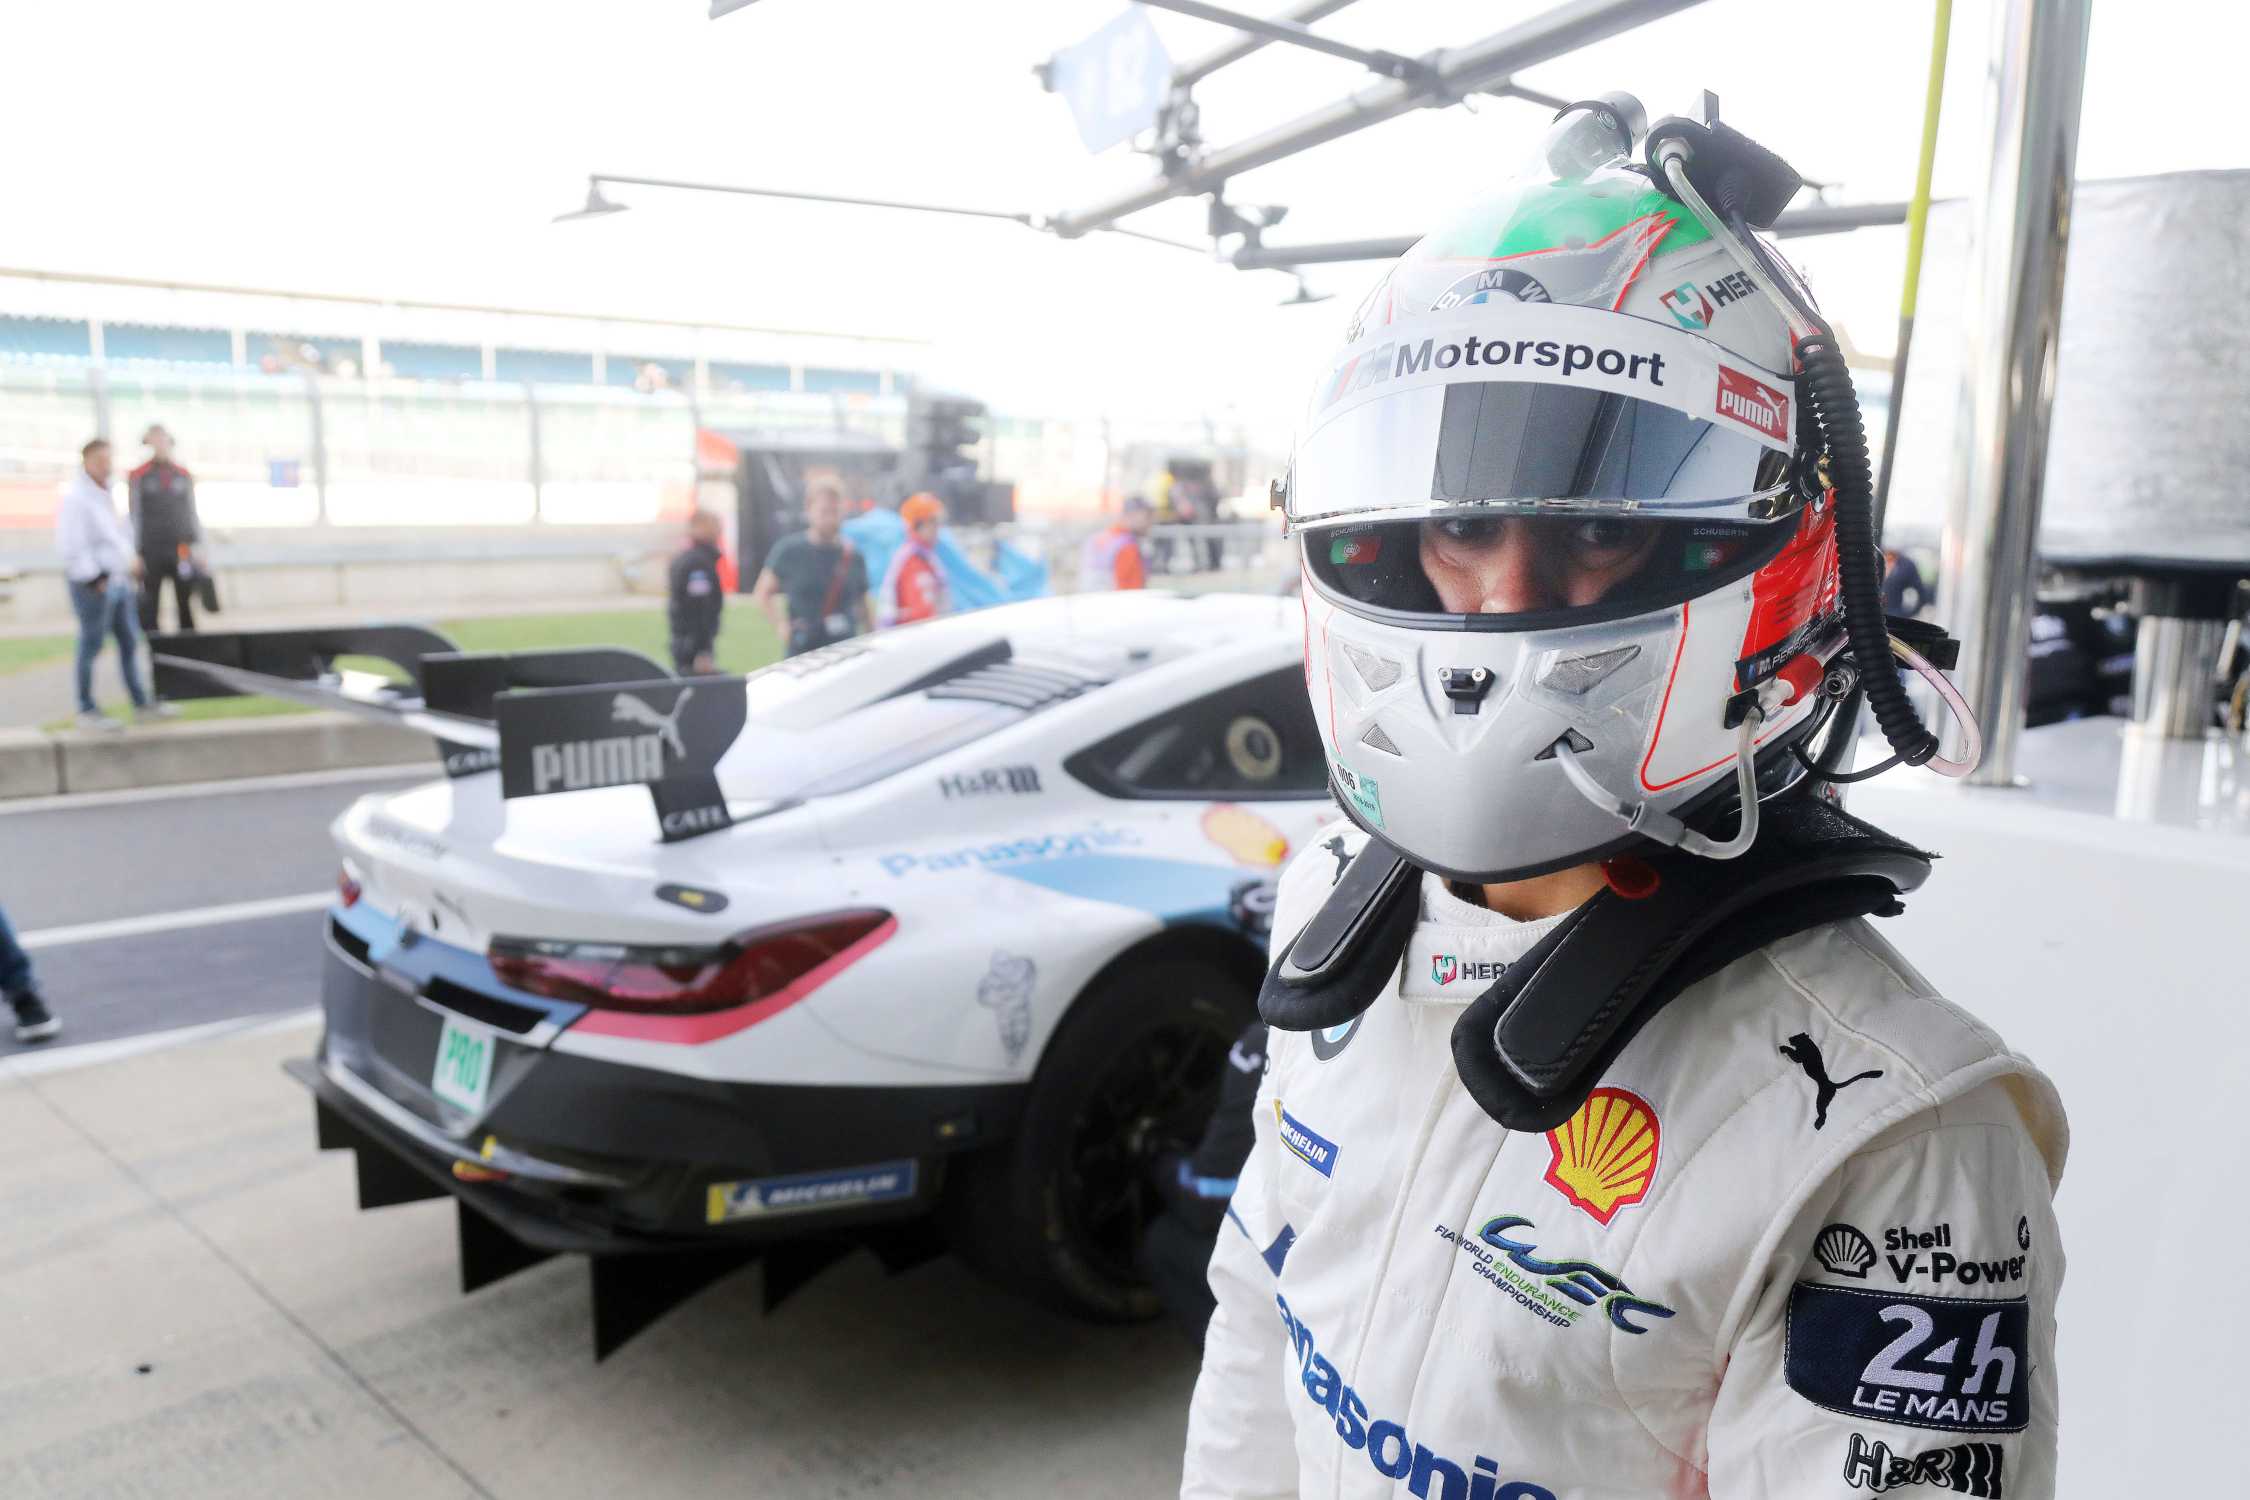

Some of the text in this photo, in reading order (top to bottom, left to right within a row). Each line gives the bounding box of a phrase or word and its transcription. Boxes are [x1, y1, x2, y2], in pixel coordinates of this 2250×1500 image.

[1705, 270, 1759, 308] HER
[1395, 336, 1665, 386] Motorsport
[1720, 389, 1774, 431] PUMA
[1693, 527, 1749, 537] SCHUBERTH
[532, 733, 664, 793] PUMA
[880, 820, 1143, 878] Panasonic
[1461, 961, 1512, 981] HER
[1280, 1119, 1328, 1164] MICHELIN
[1885, 1224, 1951, 1250] Shell
[1434, 1224, 1584, 1323] FIA WORLD ENDURANCE
[1887, 1252, 2026, 1284] V-Power
[1472, 1261, 1572, 1328] CHAMPIONSHIP
[1860, 1304, 2017, 1394] 24h
[1276, 1292, 1557, 1500] anasoni
[1852, 1386, 2008, 1423] LE MANS
